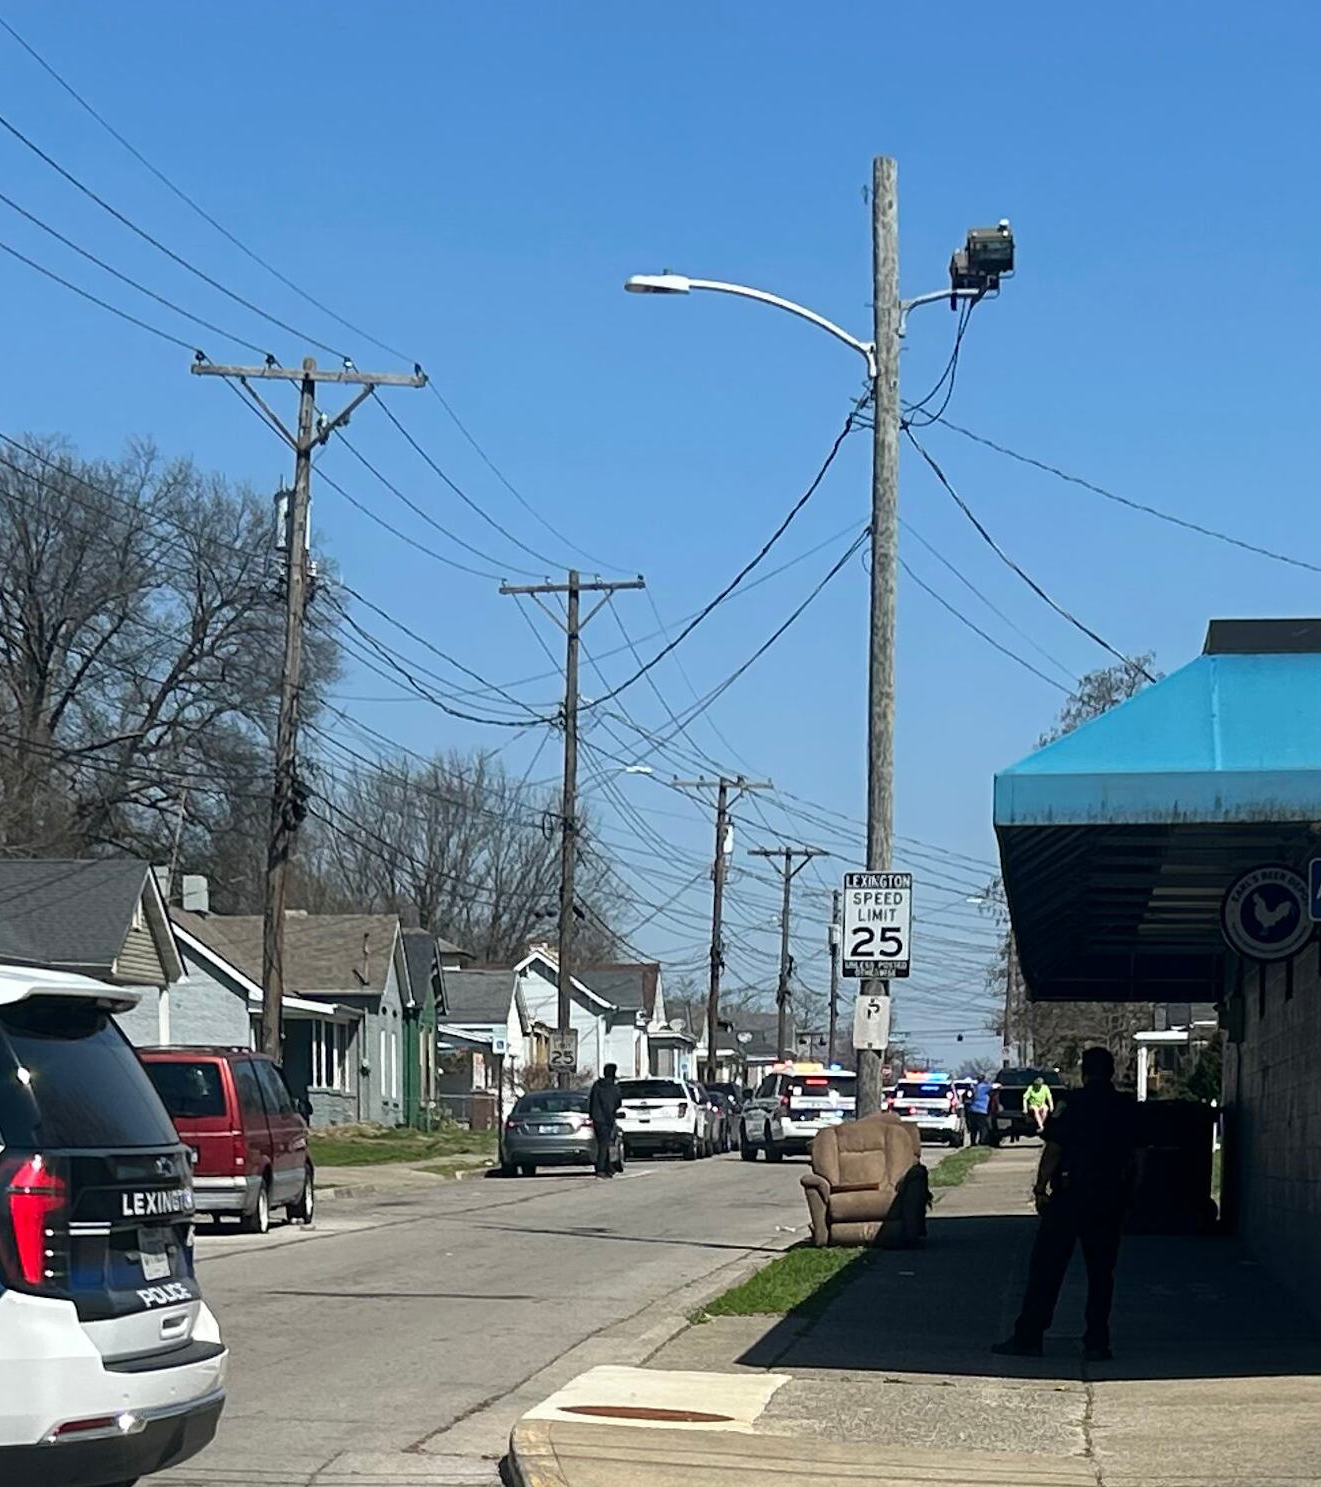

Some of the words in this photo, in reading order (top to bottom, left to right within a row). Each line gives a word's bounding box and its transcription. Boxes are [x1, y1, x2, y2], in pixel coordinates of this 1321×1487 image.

[846, 874, 910, 888] LEXINGTON
[852, 891, 903, 905] SPEED
[858, 908, 897, 922] LIMIT
[850, 926, 903, 958] 25
[551, 1050, 575, 1065] 25
